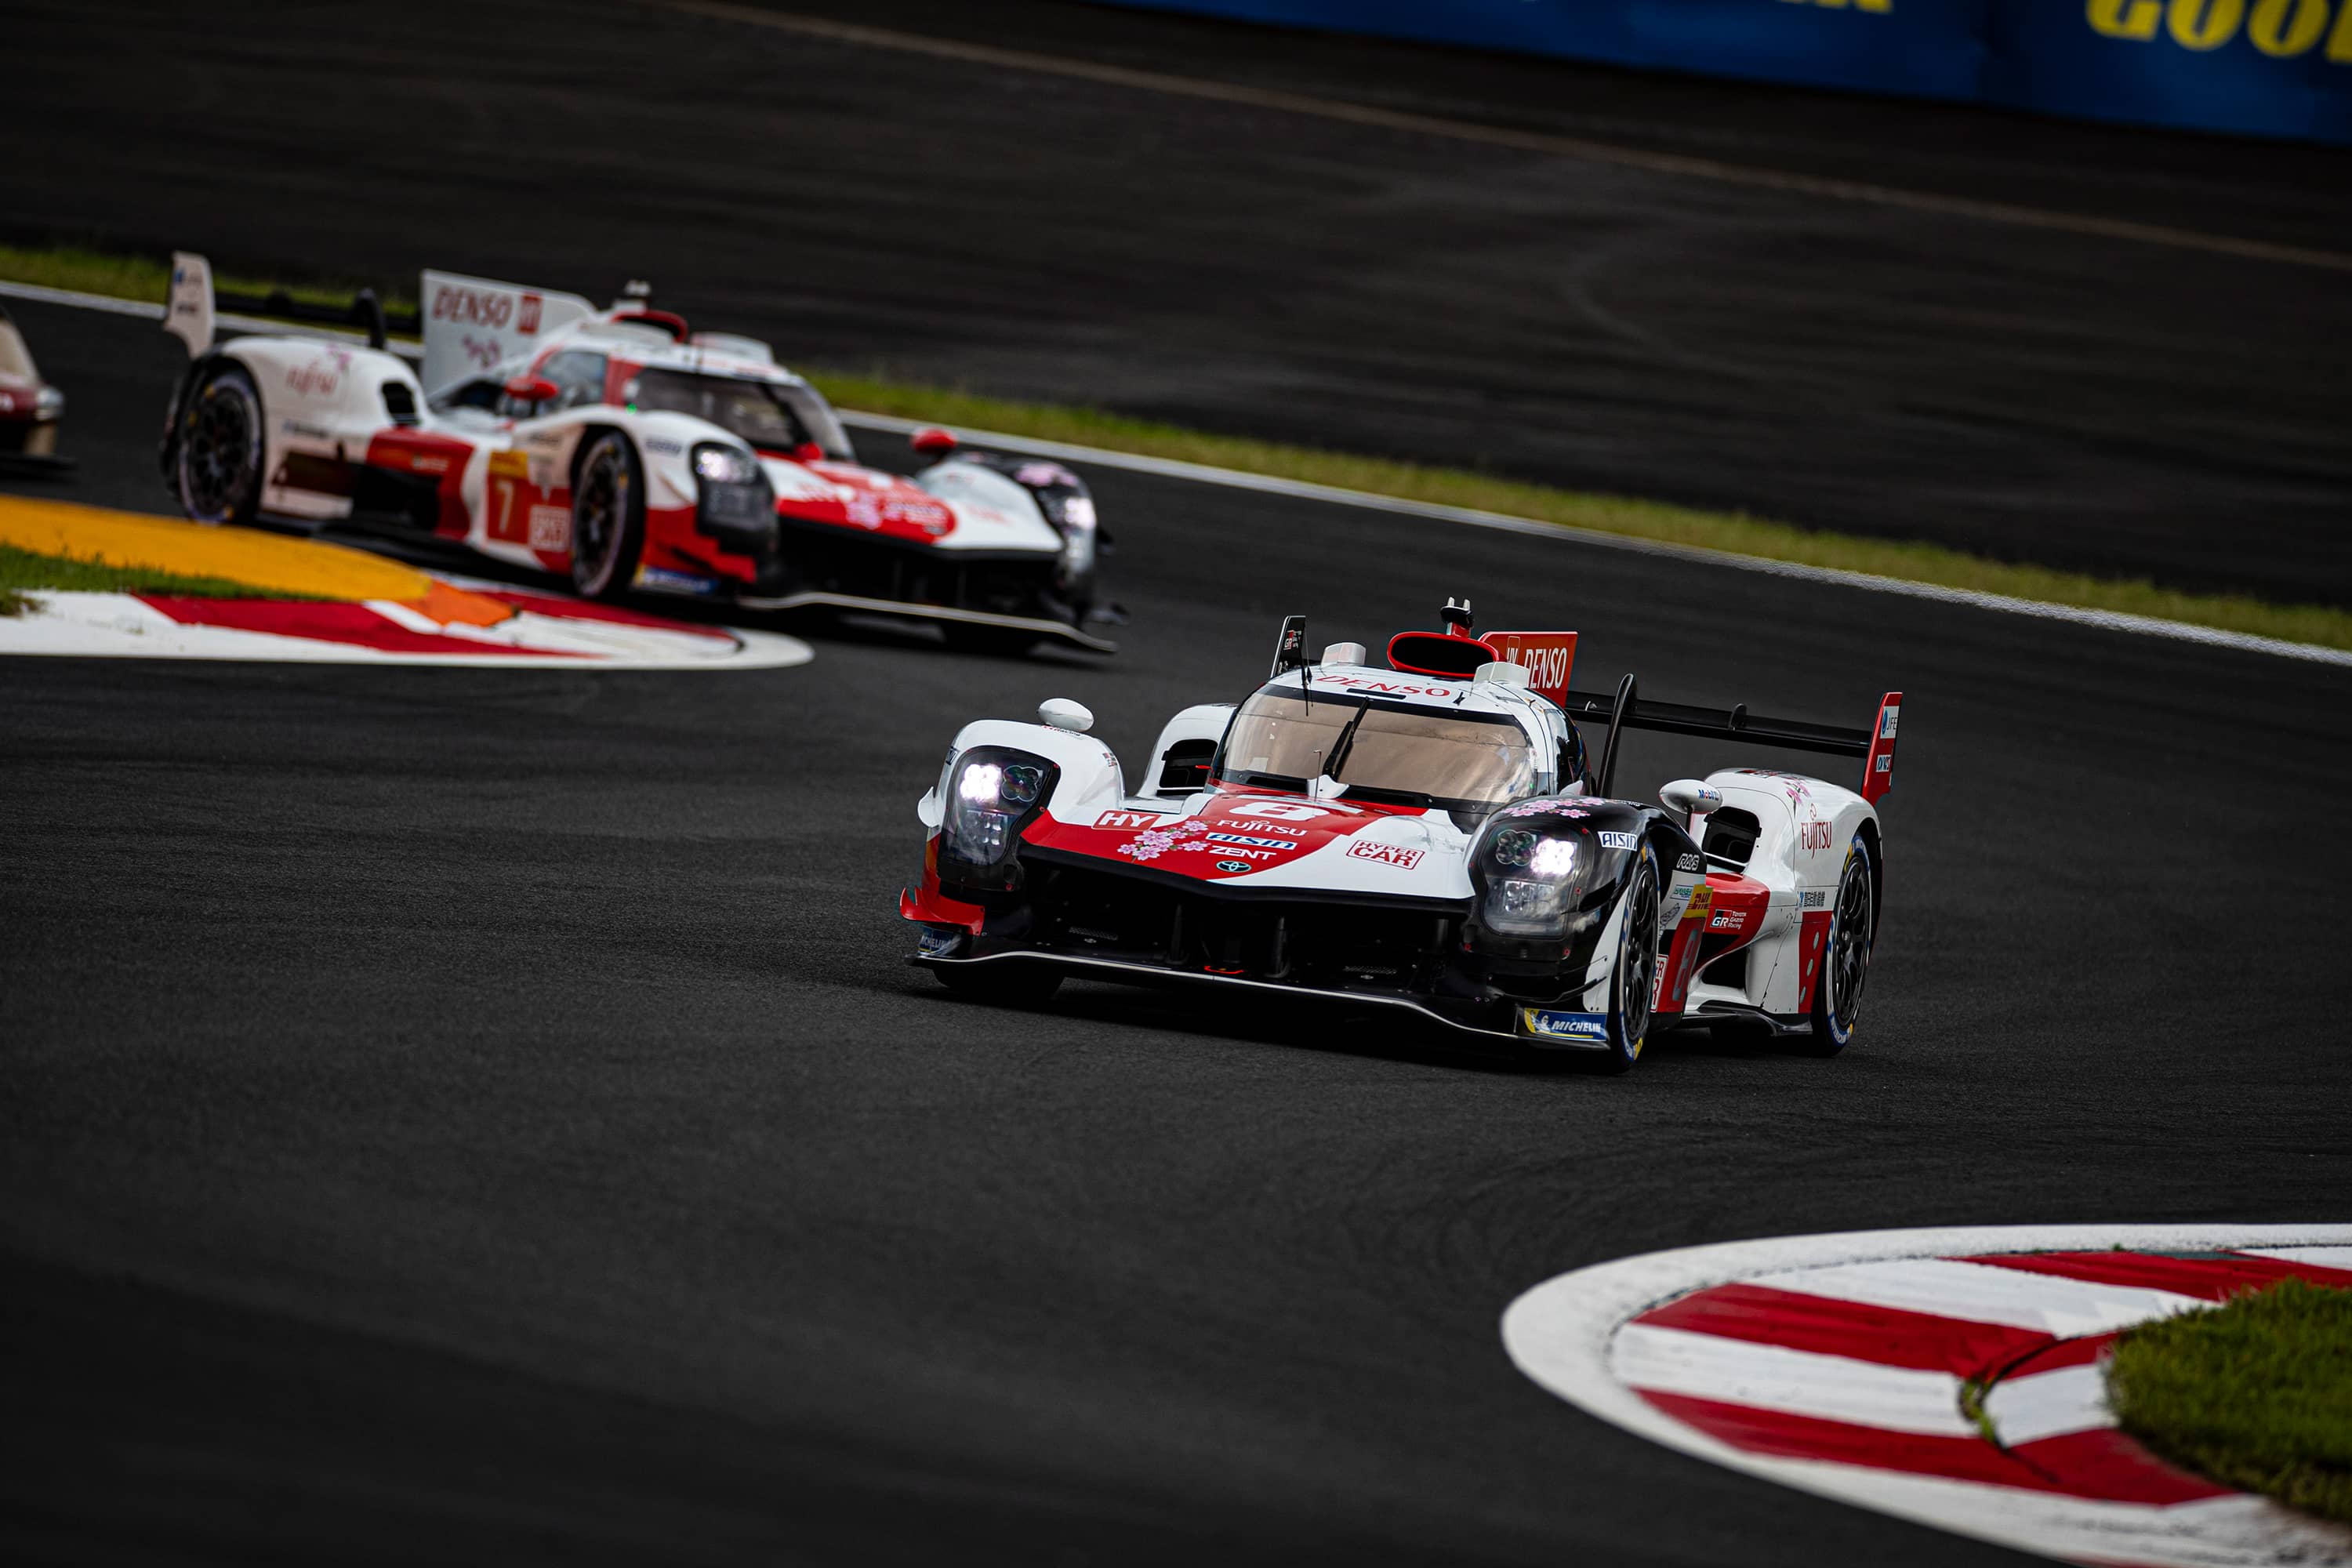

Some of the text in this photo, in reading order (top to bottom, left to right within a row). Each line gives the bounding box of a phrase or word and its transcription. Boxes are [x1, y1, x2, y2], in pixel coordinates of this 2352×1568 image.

[496, 479, 515, 534] 7
[1524, 647, 1567, 689] DENSO
[1316, 675, 1450, 697] DENSO
[1886, 717, 1898, 731] JFE
[1098, 812, 1156, 828] HY
[1229, 801, 1330, 822] 8
[1217, 819, 1308, 837] FUJITSU
[1208, 833, 1294, 849] AISIN
[1602, 833, 1637, 850] AISIN
[1801, 821, 1832, 859] FUJITSU
[1208, 846, 1277, 860] ZENT
[1353, 847, 1414, 866] CAR
[1359, 841, 1418, 857] HYPER
[1676, 853, 1700, 871] RAYS
[1711, 916, 1729, 927] GR
[1552, 1020, 1601, 1033] MICHELIN
